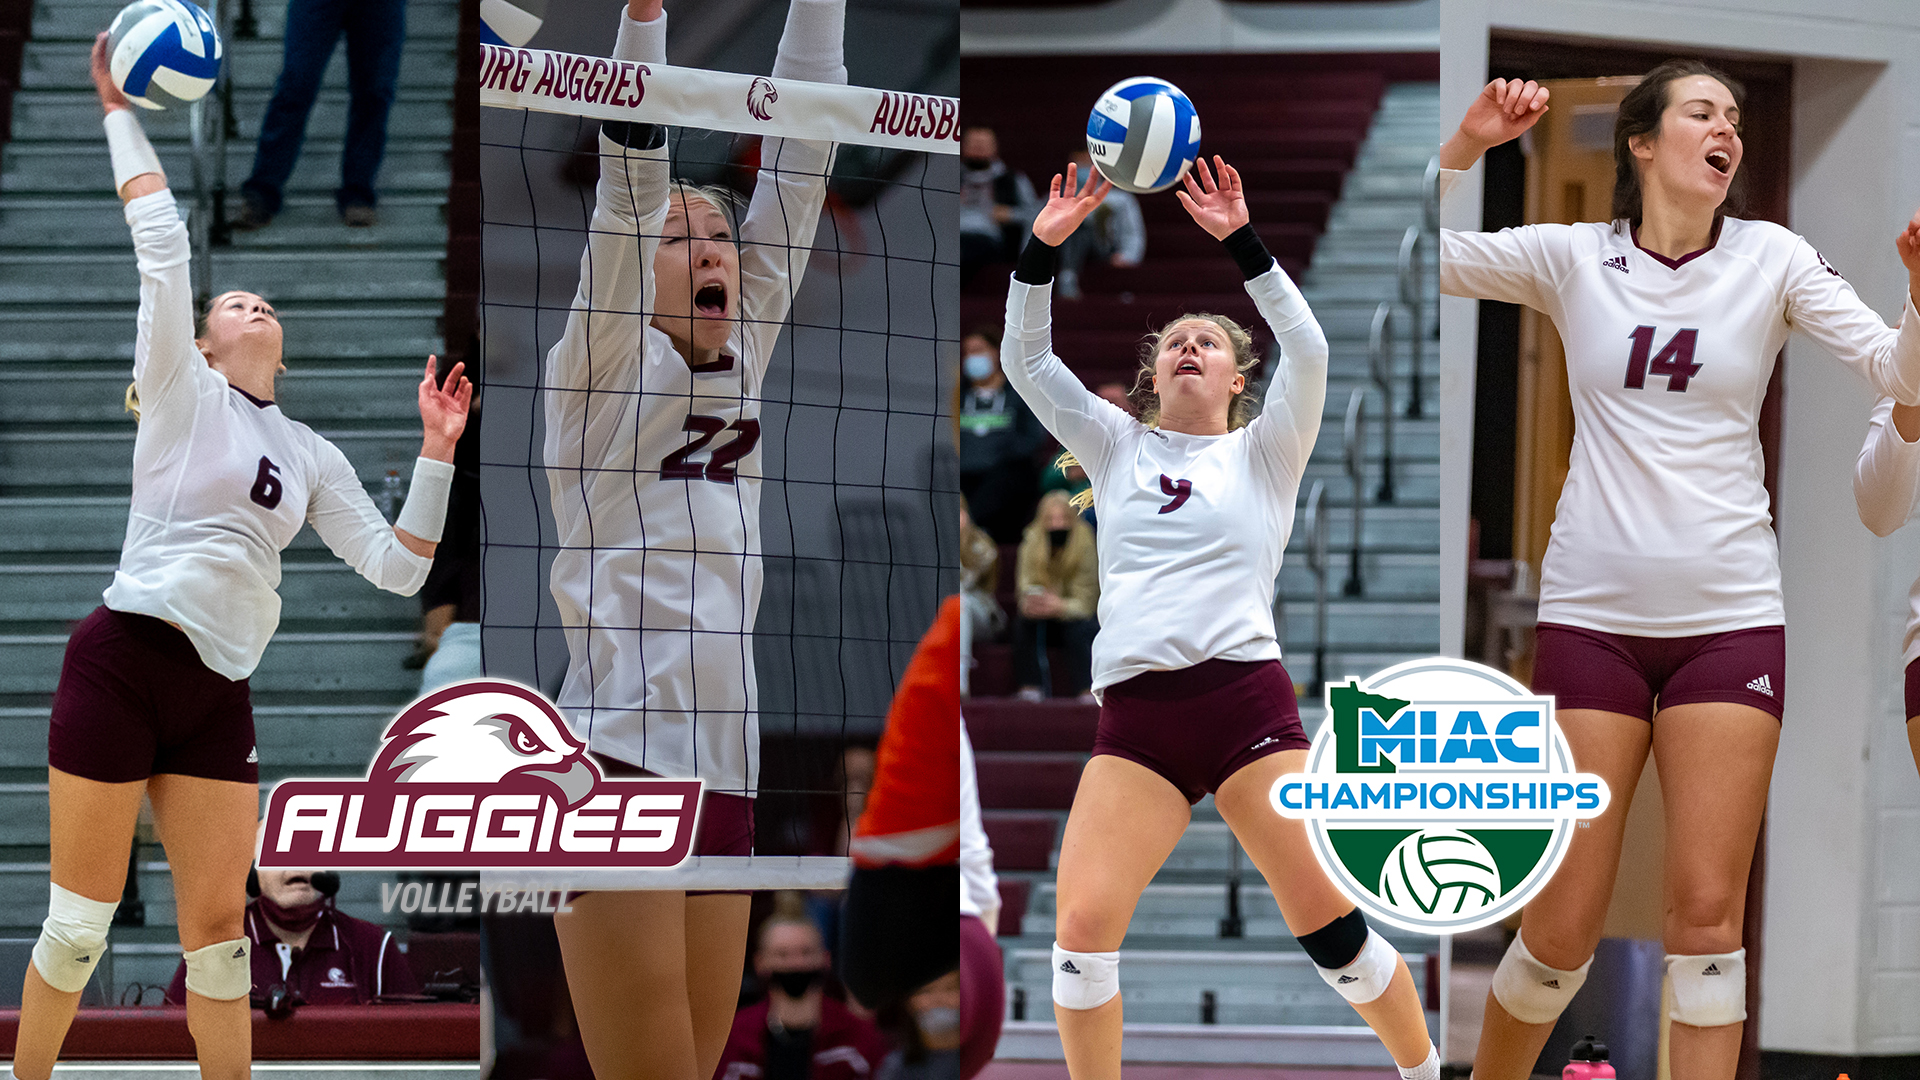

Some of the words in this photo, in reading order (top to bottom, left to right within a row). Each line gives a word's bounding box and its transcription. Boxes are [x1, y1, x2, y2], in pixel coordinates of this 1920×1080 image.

[532, 52, 652, 108] AUGGIES
[1602, 260, 1630, 274] adidas
[1623, 324, 1703, 393] 14
[659, 413, 761, 485] 22
[250, 454, 283, 511] 6
[1157, 473, 1193, 515] 9
[1746, 682, 1774, 697] adidas
